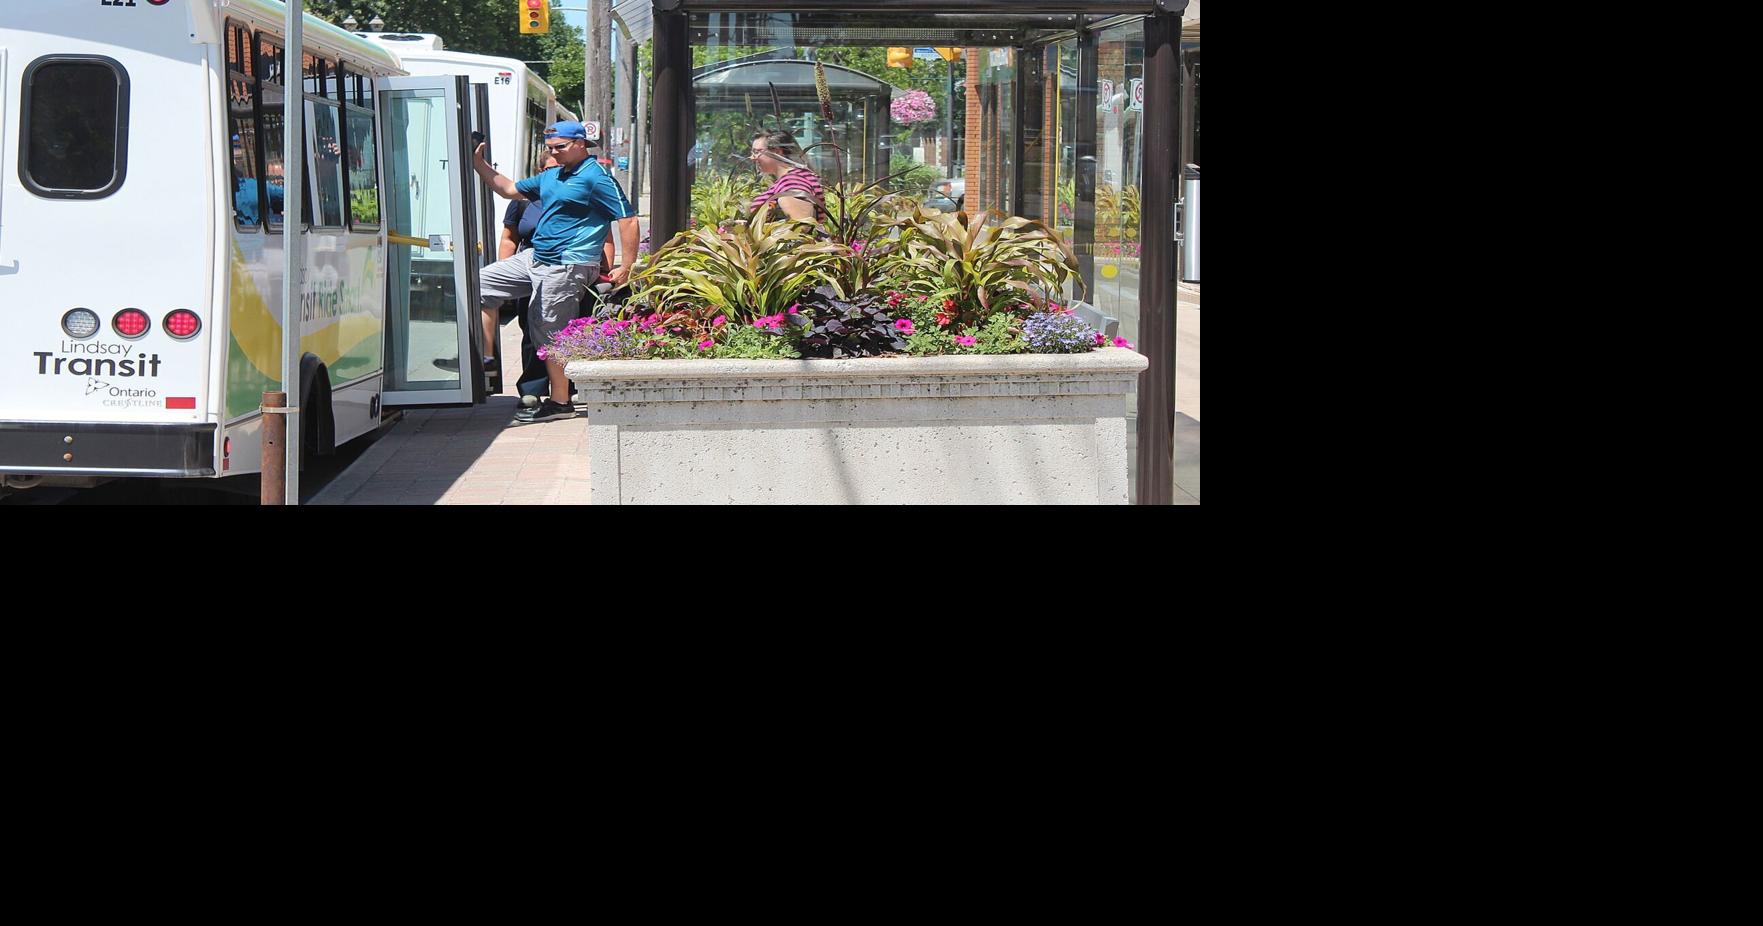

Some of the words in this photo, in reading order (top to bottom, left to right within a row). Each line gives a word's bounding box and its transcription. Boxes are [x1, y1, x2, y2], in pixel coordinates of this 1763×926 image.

[494, 76, 510, 85] E16
[61, 340, 133, 357] Lindsay
[33, 352, 162, 377] Transit
[108, 387, 156, 397] Ontario
